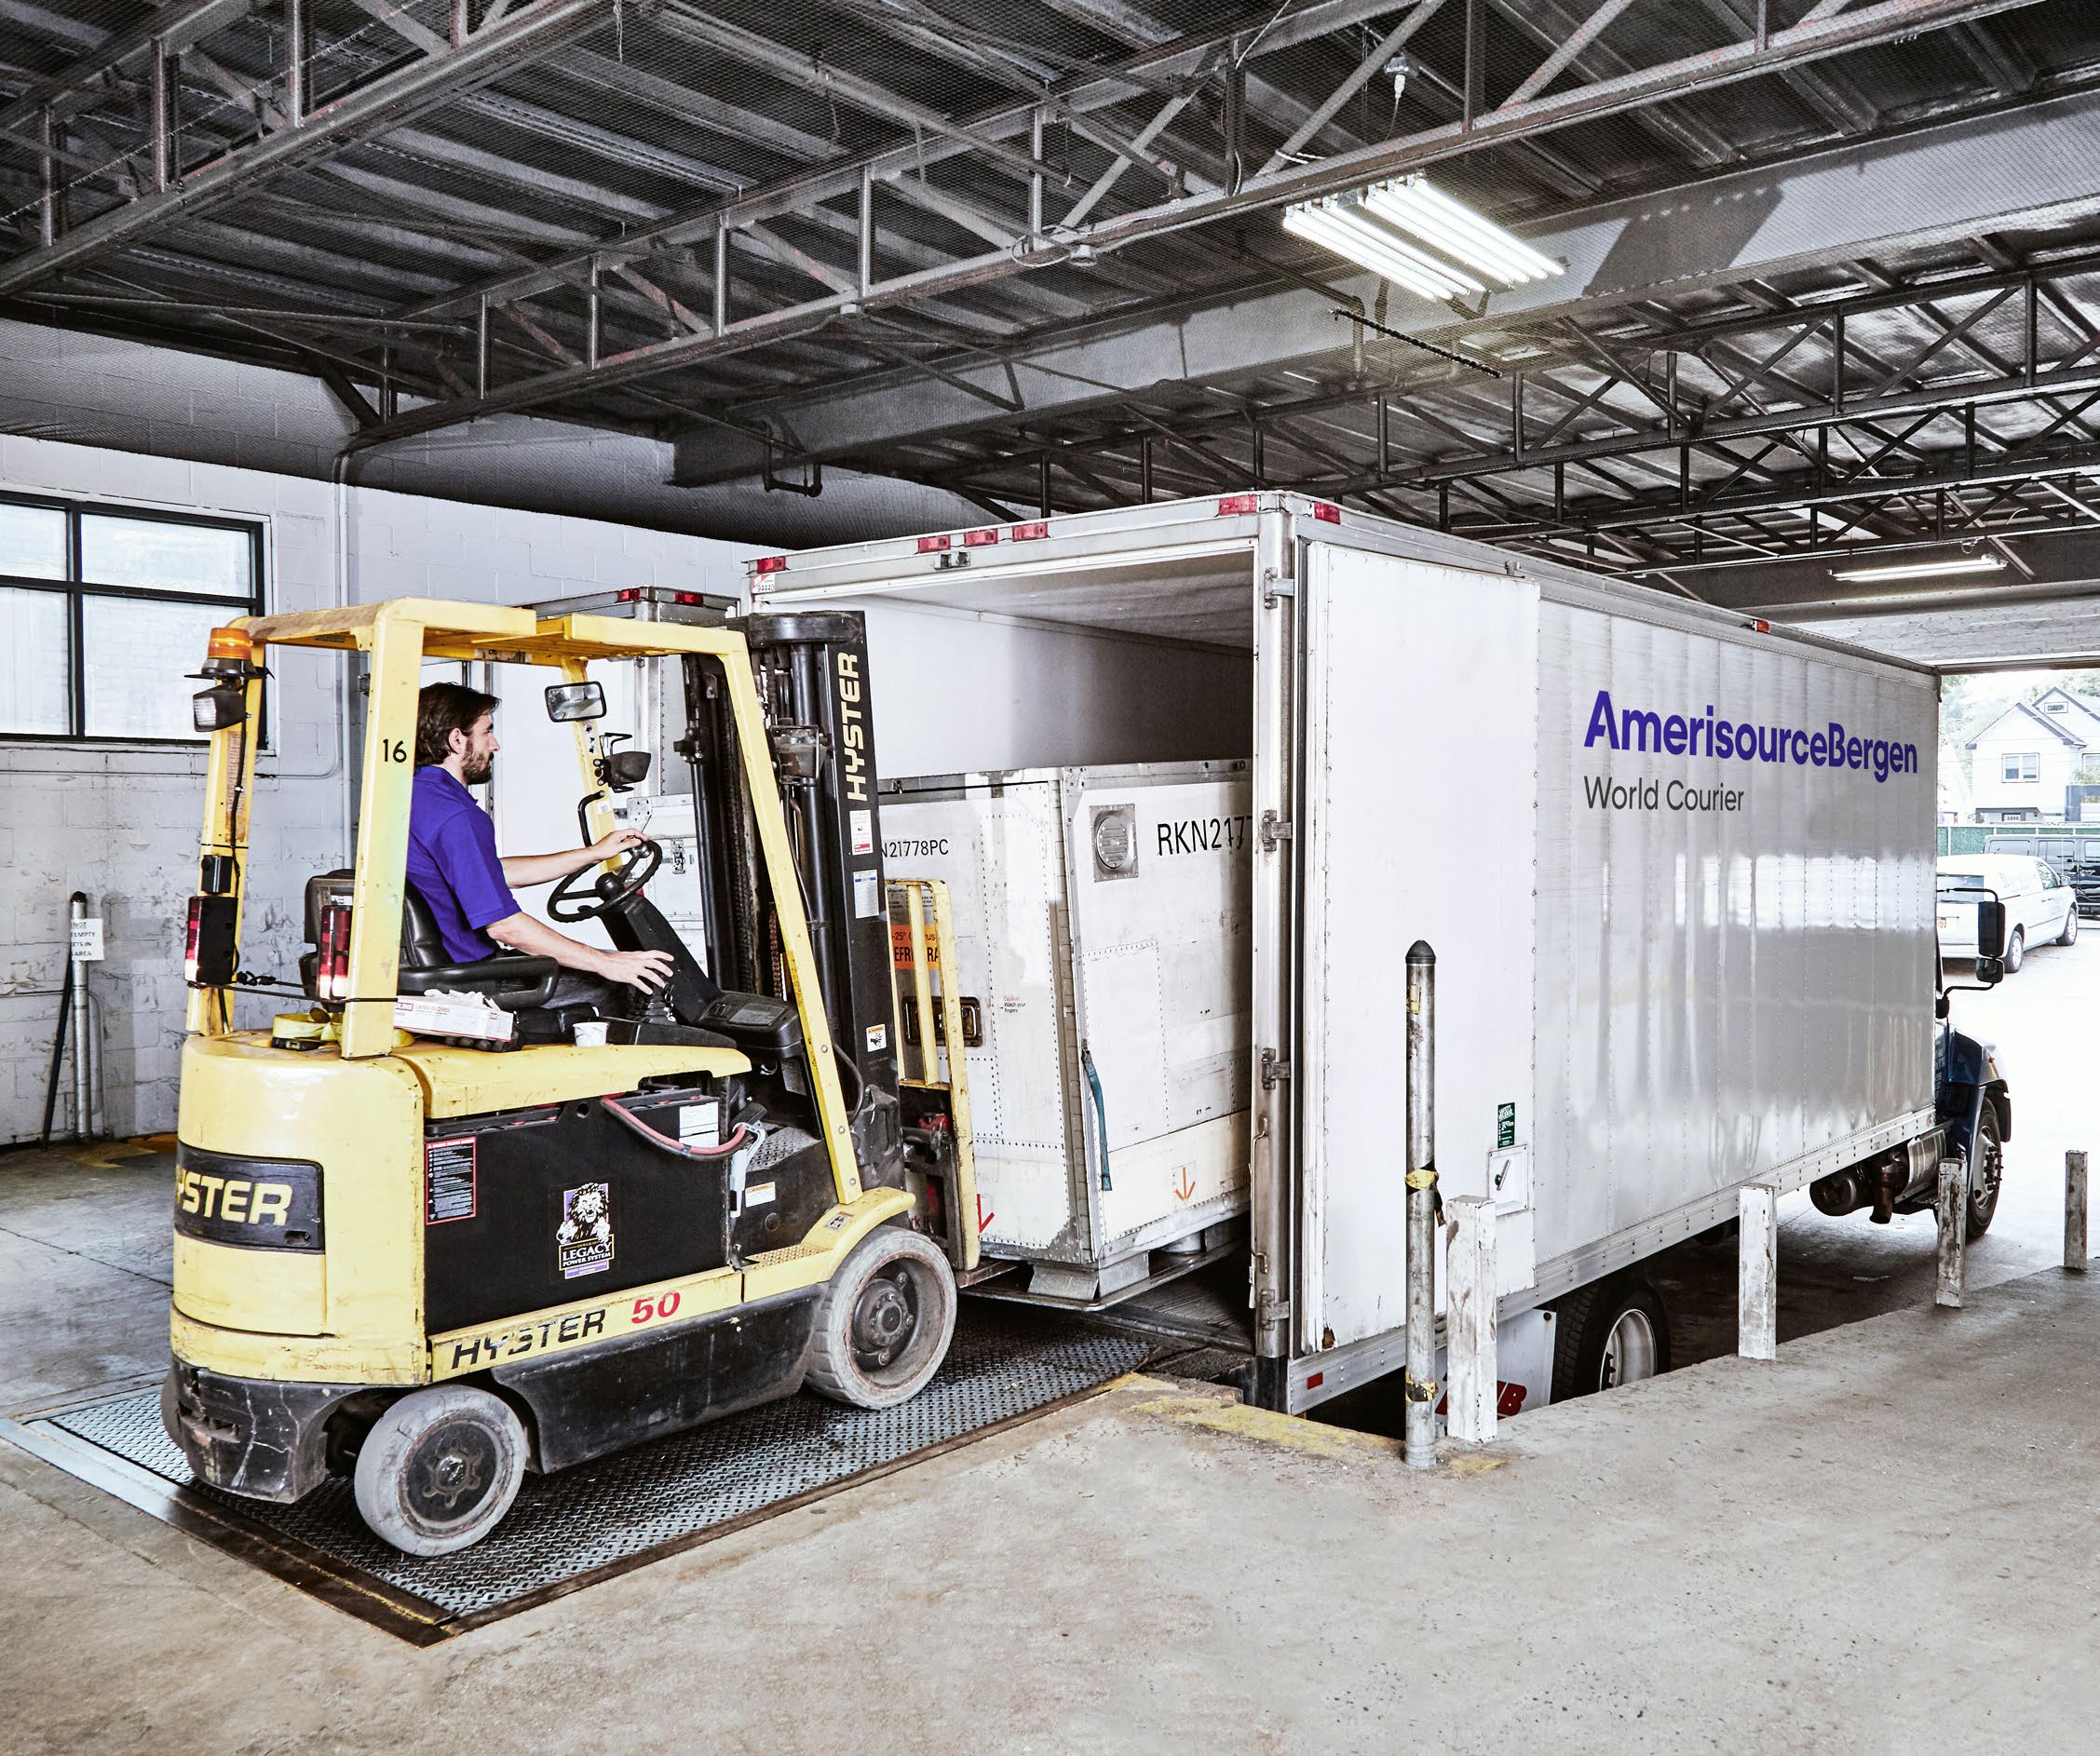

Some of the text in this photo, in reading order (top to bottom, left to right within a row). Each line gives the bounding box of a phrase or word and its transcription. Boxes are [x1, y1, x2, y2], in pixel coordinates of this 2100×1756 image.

[838, 652, 868, 802] HYSTER
[1583, 690, 1918, 783] AmerisourceBergen
[383, 738, 408, 763] 16
[1583, 776, 1744, 812] World Courier
[882, 838, 950, 858] N21778PC
[562, 1242, 611, 1261] LEGACY
[562, 1251, 611, 1267] POWER SYSTEM
[452, 1290, 681, 1370] HYSTER 50
